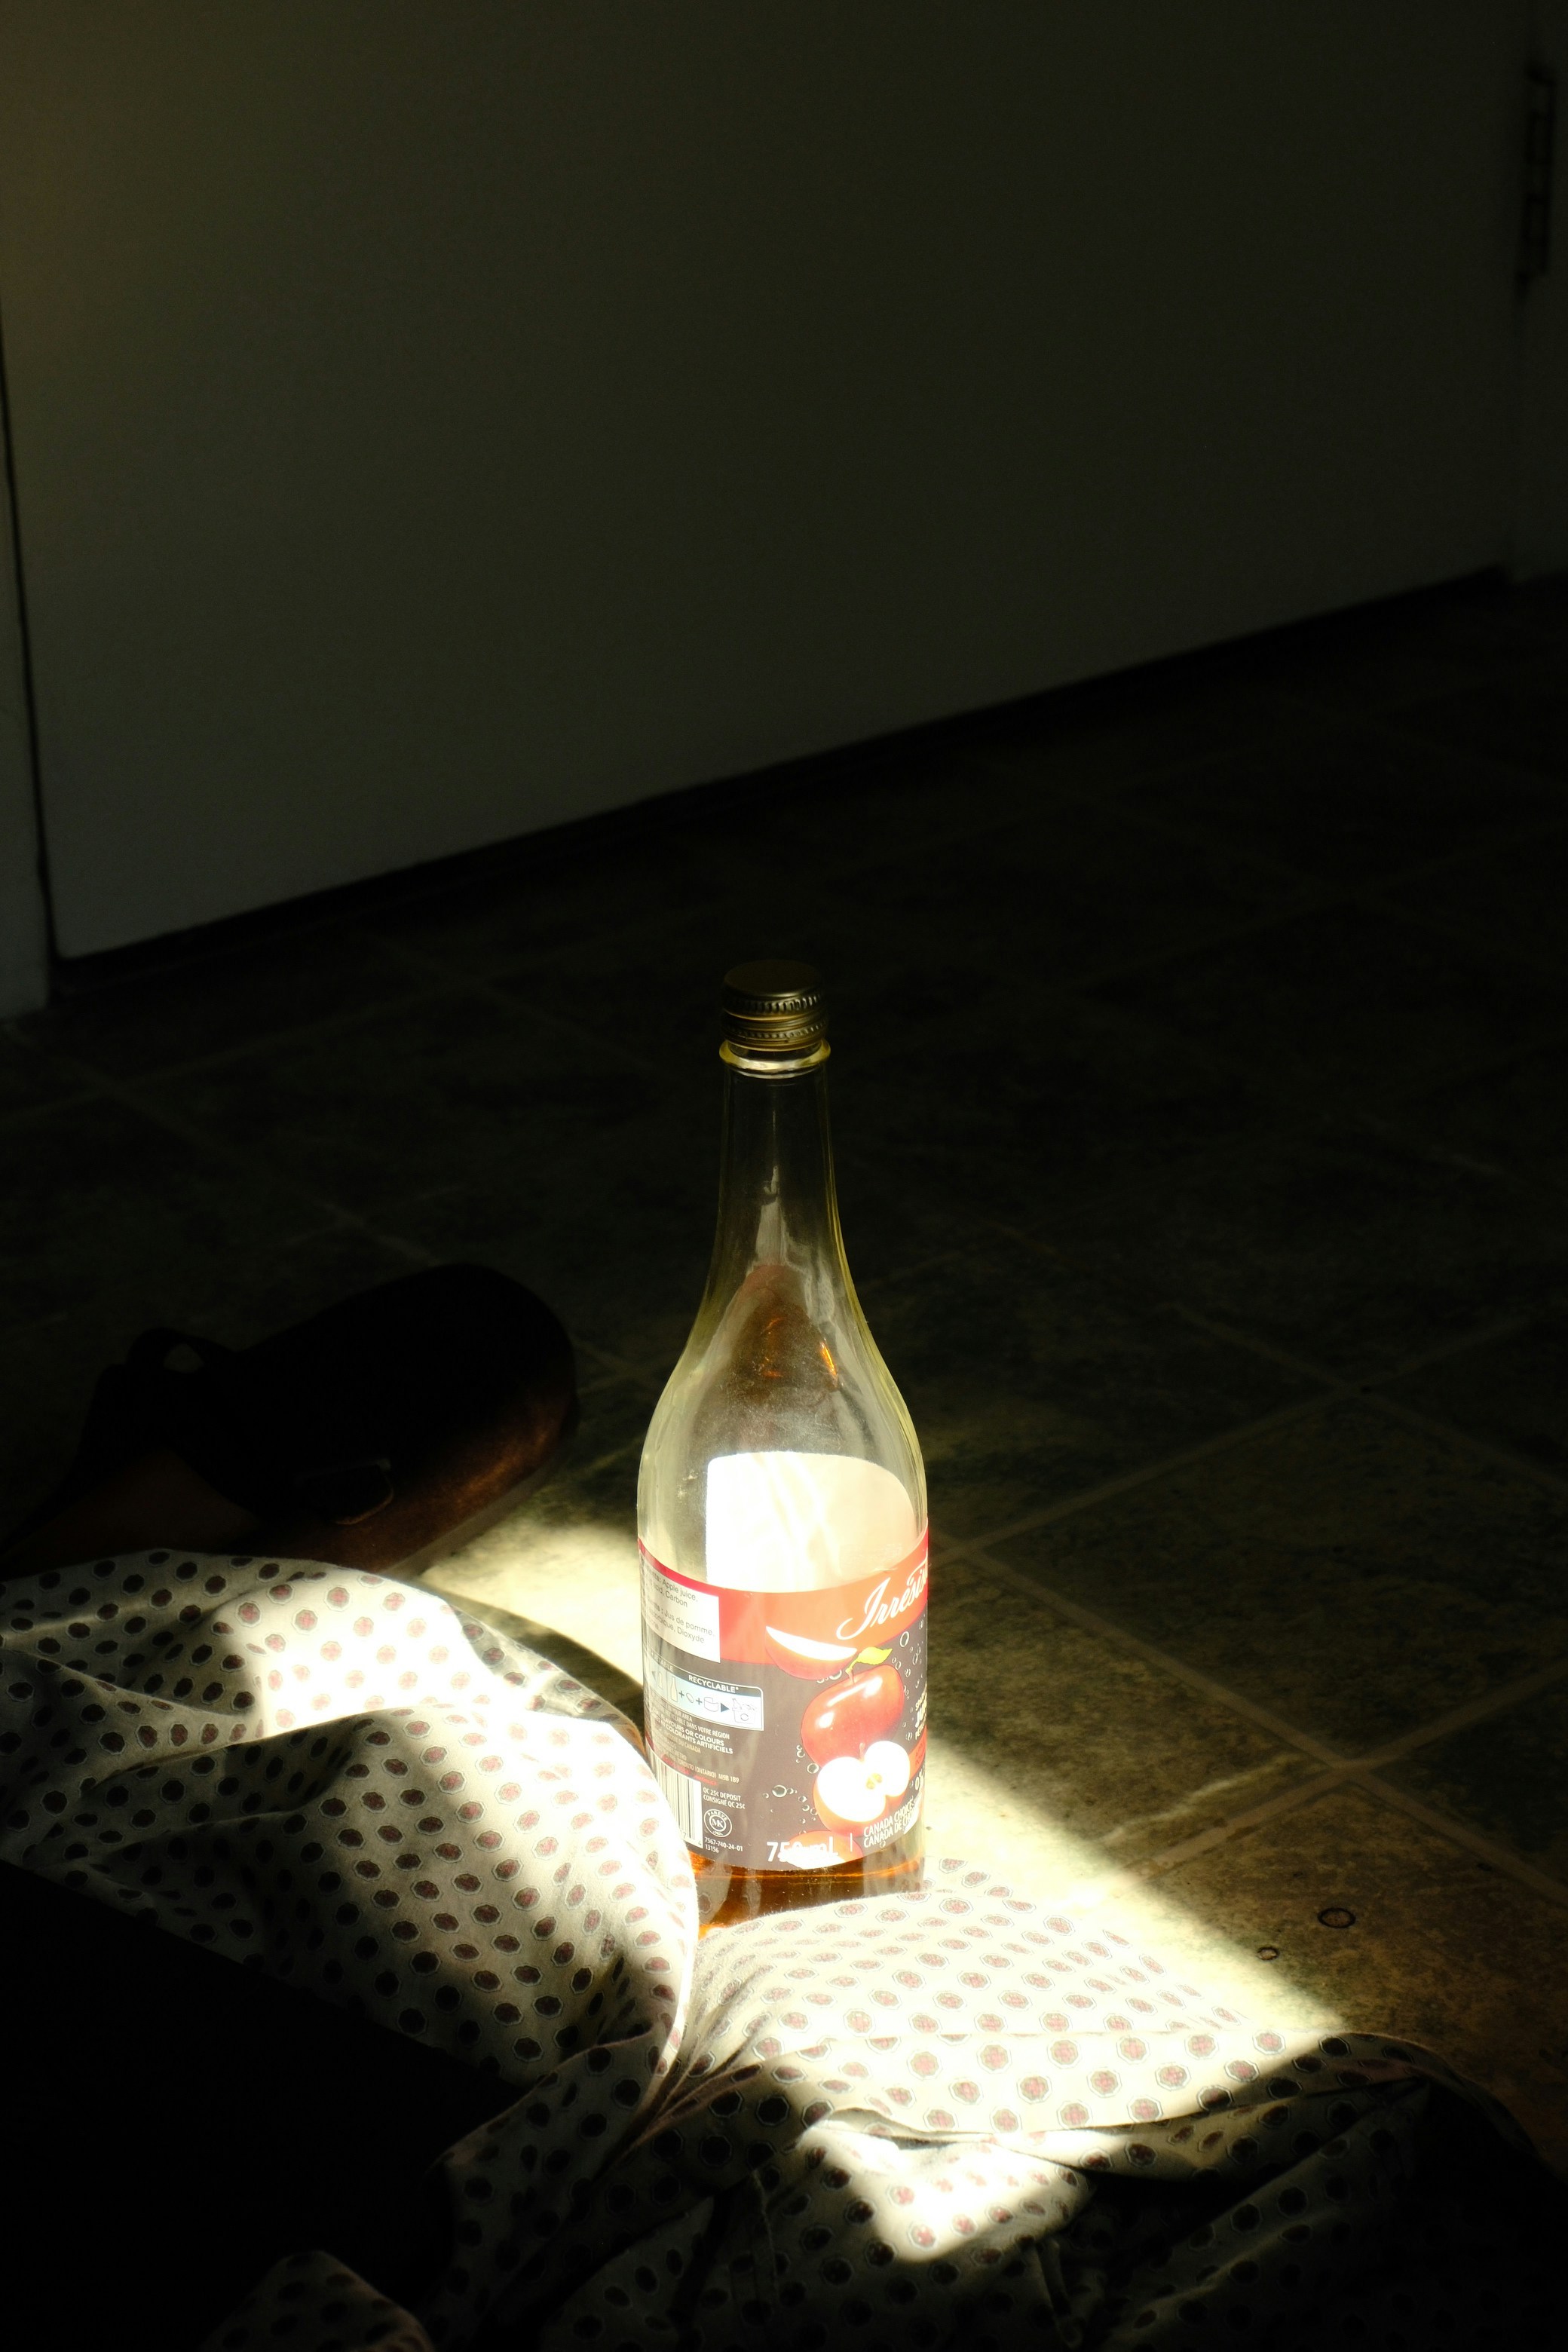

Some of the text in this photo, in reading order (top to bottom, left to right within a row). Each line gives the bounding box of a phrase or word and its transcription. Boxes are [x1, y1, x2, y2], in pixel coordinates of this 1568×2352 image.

[663, 1579, 678, 1592] Apple
[665, 1591, 688, 1607] Carbon
[664, 1610, 675, 1621] Jus
[675, 1617, 684, 1625] de
[677, 1626, 704, 1643] Dioxyde
[682, 1713, 693, 1722] AREA
[661, 1714, 684, 1732] FLAVOURS
[685, 1729, 694, 1737] OR
[694, 1732, 724, 1746] COLOURS
[686, 1721, 697, 1731] DANS
[698, 1726, 712, 1735] VOTRE
[712, 1730, 730, 1740] RÉGION
[666, 1724, 696, 1744] COLORANTS
[697, 1740, 733, 1754] ARTIFICIELS
[684, 1742, 701, 1753] CANADA
[720, 1792, 741, 1802] DEPOSIT
[863, 1815, 893, 1837] CANADA
[863, 1826, 893, 1848] CANADA
[894, 1820, 902, 1833] DE
